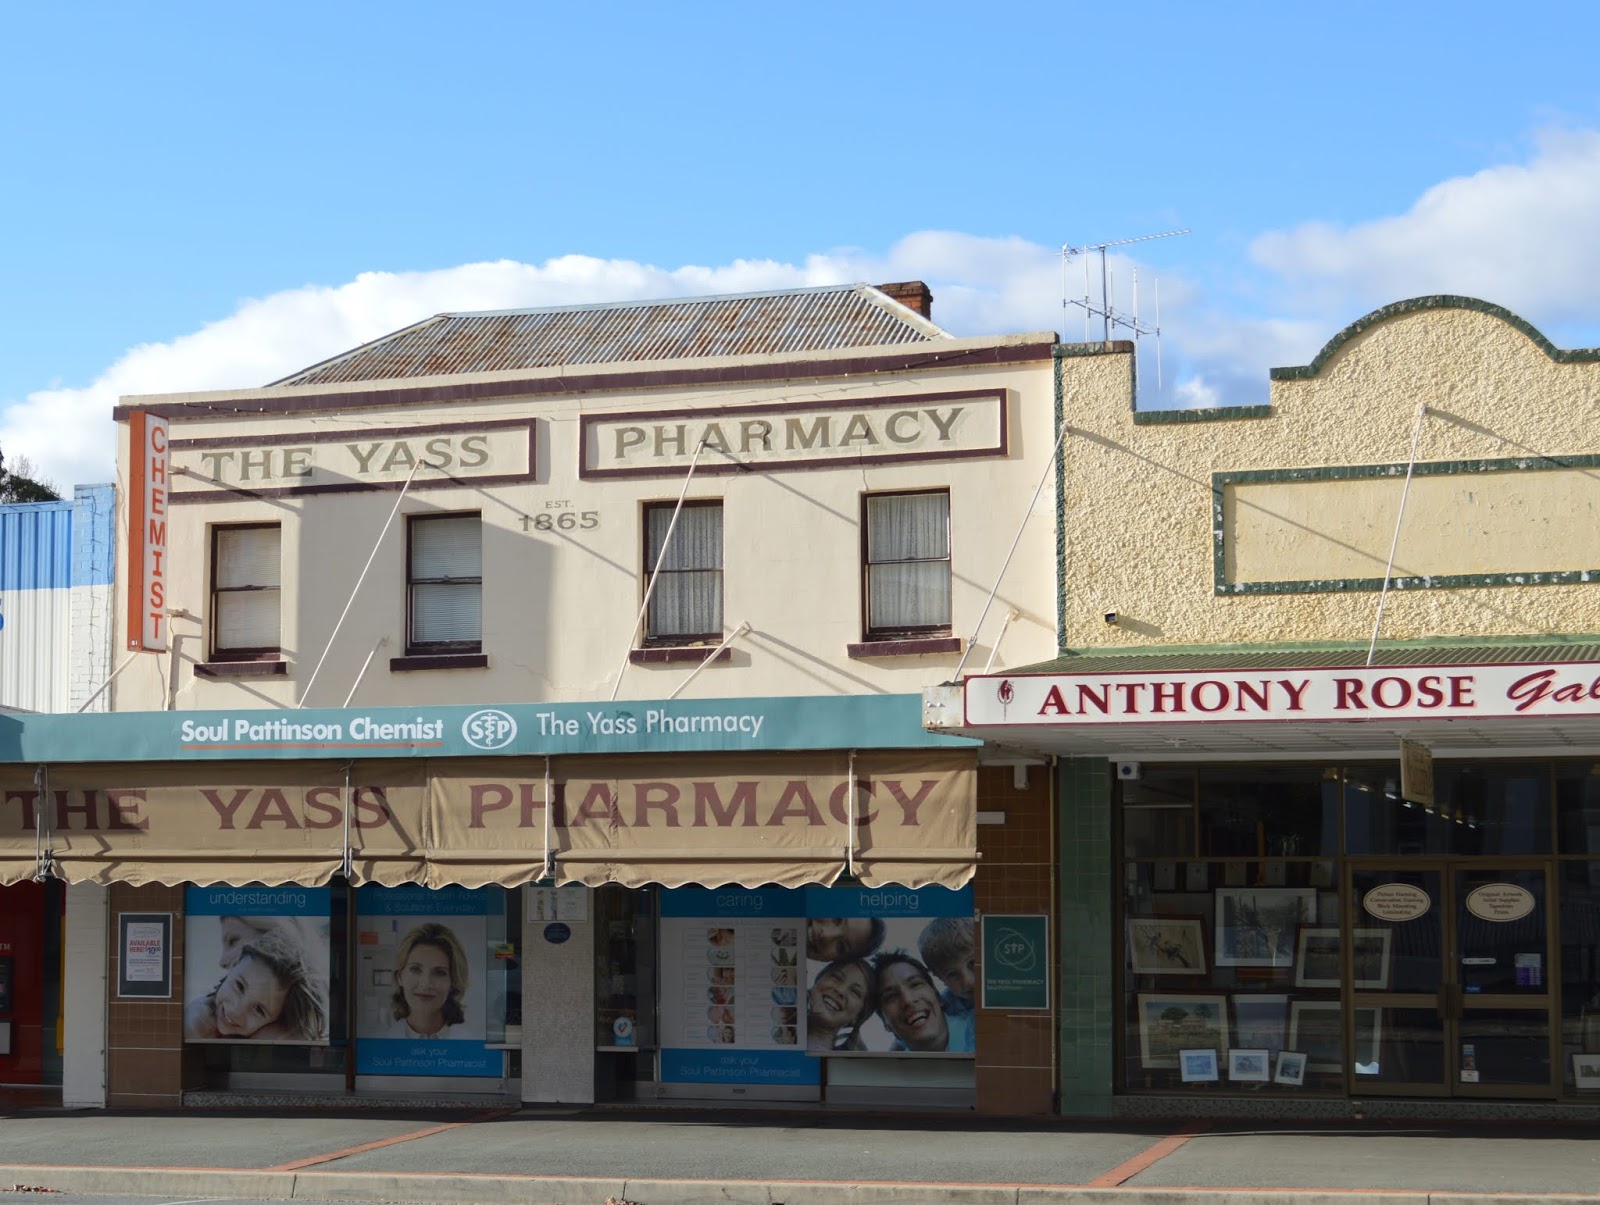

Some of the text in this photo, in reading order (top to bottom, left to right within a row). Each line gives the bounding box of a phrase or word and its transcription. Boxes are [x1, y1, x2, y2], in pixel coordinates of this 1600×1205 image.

[614, 407, 965, 459] PHARMACY
[201, 436, 489, 481] THE YASS
[545, 500, 574, 509] EST.
[518, 511, 598, 531] 1865
[149, 426, 166, 639] CHEMIST
[1037, 680, 1310, 714] ANTHONY
[1333, 676, 1474, 710] ROSE
[181, 717, 443, 742] Soul Pattinson Chemist
[536, 709, 764, 738] The Yass Pharmacy
[5, 780, 941, 830] THE YASS PHARMACY
[209, 891, 306, 908] understanding
[716, 894, 763, 911] caring
[860, 891, 919, 909] helping
[372, 1057, 487, 1068] Soul Pattinson Pharmacist
[429, 1048, 448, 1057] your
[680, 1066, 801, 1077] Soul Pattinson Pharmacist
